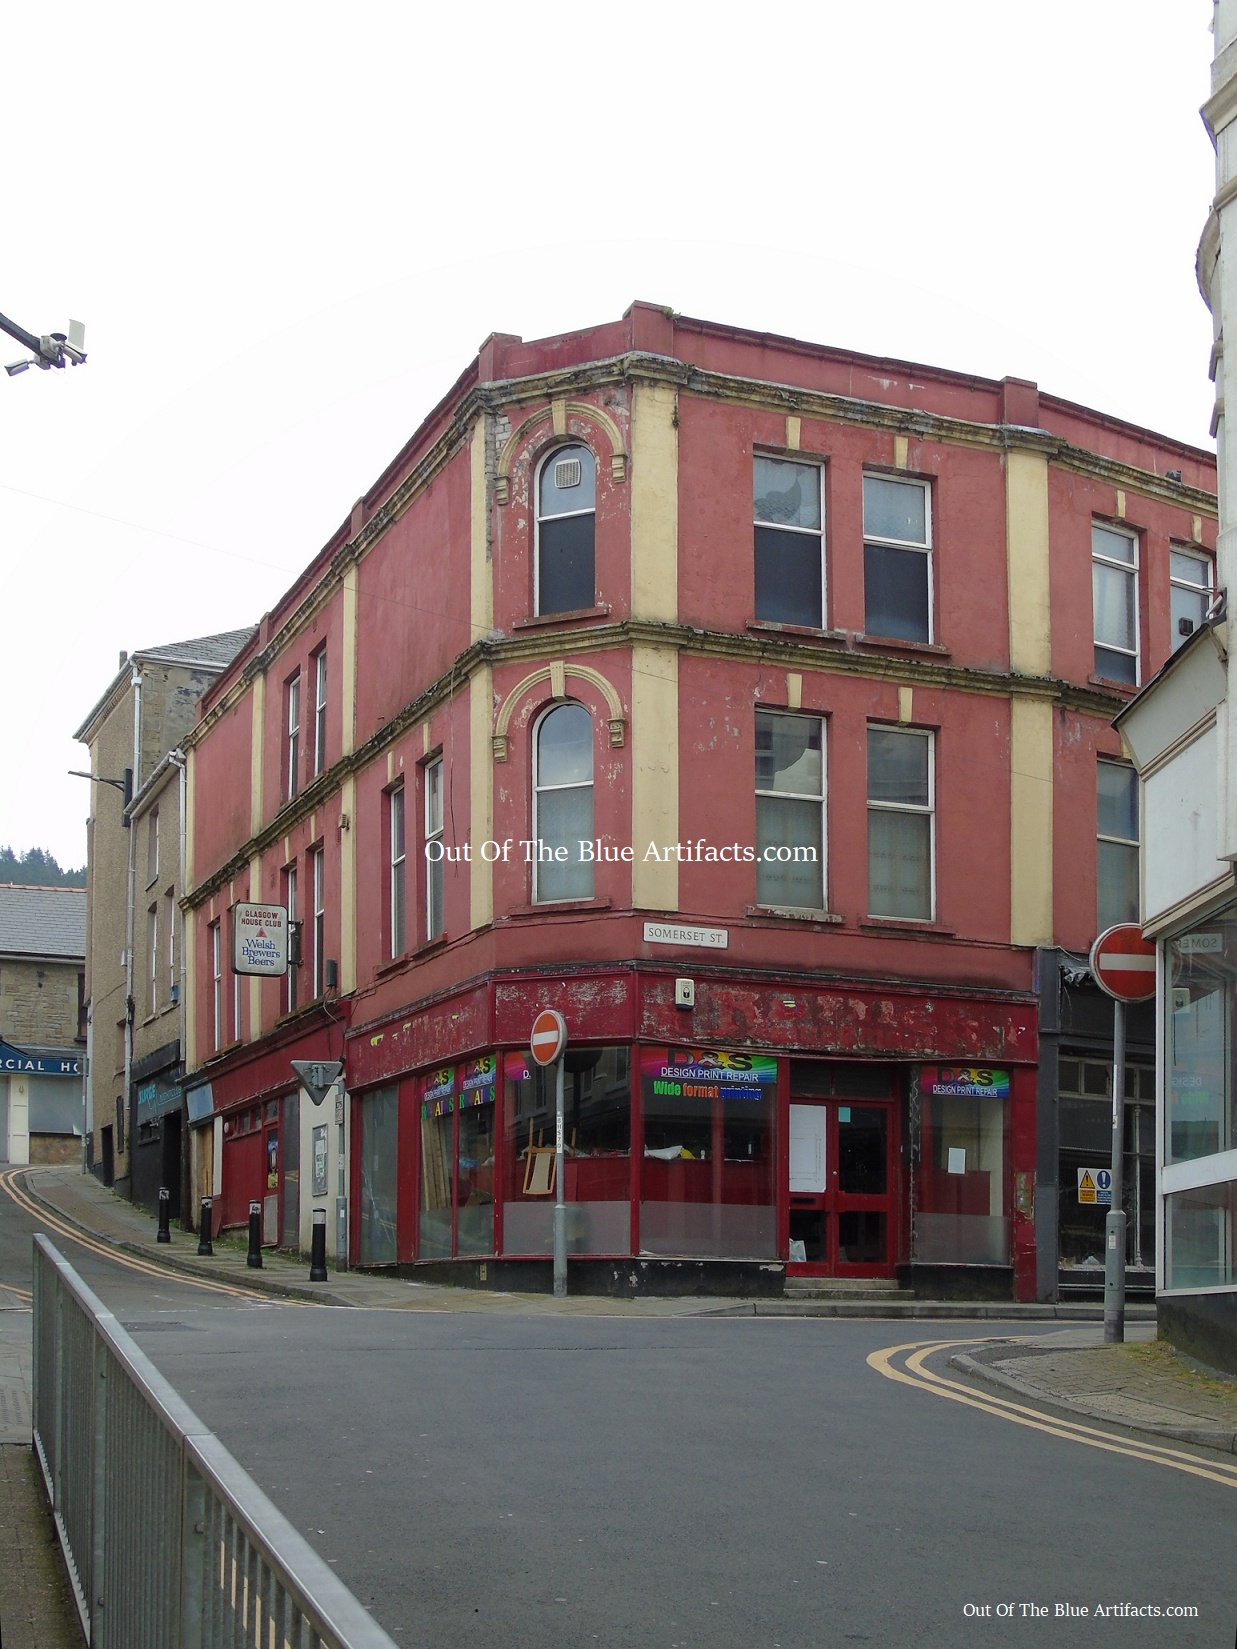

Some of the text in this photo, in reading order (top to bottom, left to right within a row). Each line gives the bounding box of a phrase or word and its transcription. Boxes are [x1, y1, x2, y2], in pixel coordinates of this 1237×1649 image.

[245, 910, 278, 919] GLASGOW
[241, 918, 263, 926] HOUSE
[648, 927, 724, 944] SOMERSET ST.
[245, 938, 276, 950] Welsh
[242, 946, 281, 958] Brewers
[248, 956, 275, 966] Beers
[0, 1059, 45, 1071] CIAL
[667, 1048, 753, 1072] D&S
[661, 1067, 759, 1082] DESIGN PRINT REPAIR
[938, 1067, 994, 1087] D&S
[653, 1080, 682, 1096] Wide
[682, 1082, 719, 1099] format
[933, 1084, 998, 1097] DESIGN PRINT REPAIR
